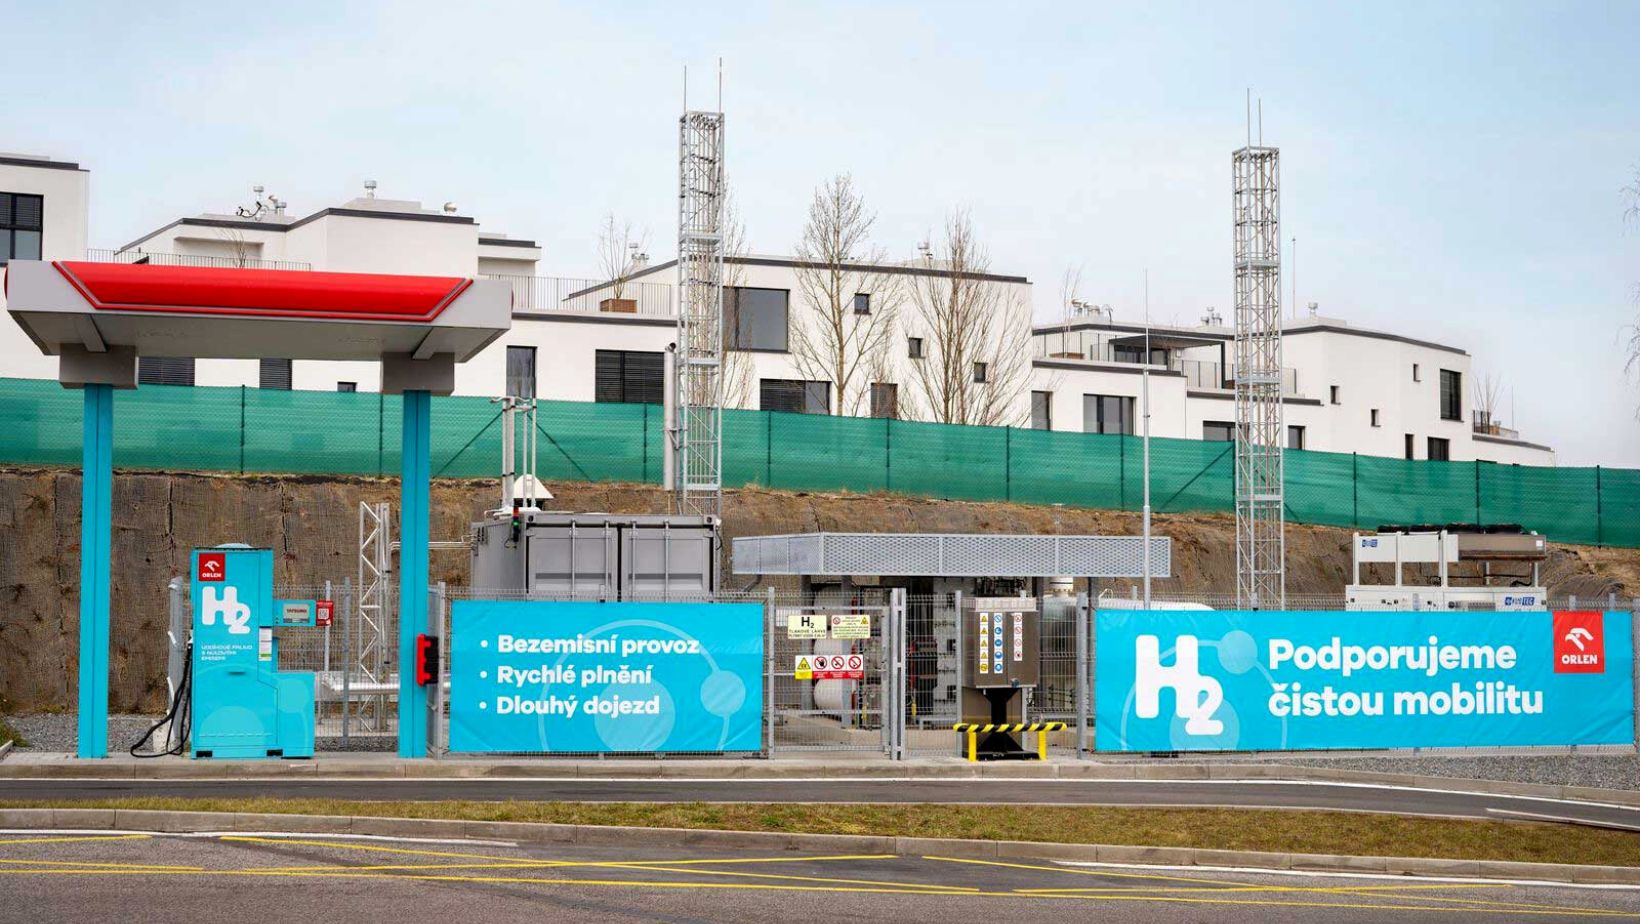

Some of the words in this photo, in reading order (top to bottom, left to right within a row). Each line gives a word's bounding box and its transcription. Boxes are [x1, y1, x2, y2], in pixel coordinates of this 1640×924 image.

[202, 586, 251, 634] H2
[801, 616, 815, 628] H2
[498, 633, 617, 654] Bezemisní
[622, 638, 700, 657] provoz
[1268, 635, 1517, 677] Podporujeme
[1561, 654, 1599, 665] ORLEN
[497, 664, 576, 688] Rychlé
[581, 664, 653, 688] plnění
[1135, 635, 1224, 736] H2
[496, 695, 578, 718] Dlouhý
[583, 694, 660, 719] dojezd
[1267, 682, 1384, 717] čistou
[1394, 681, 1544, 716] mobilitu
